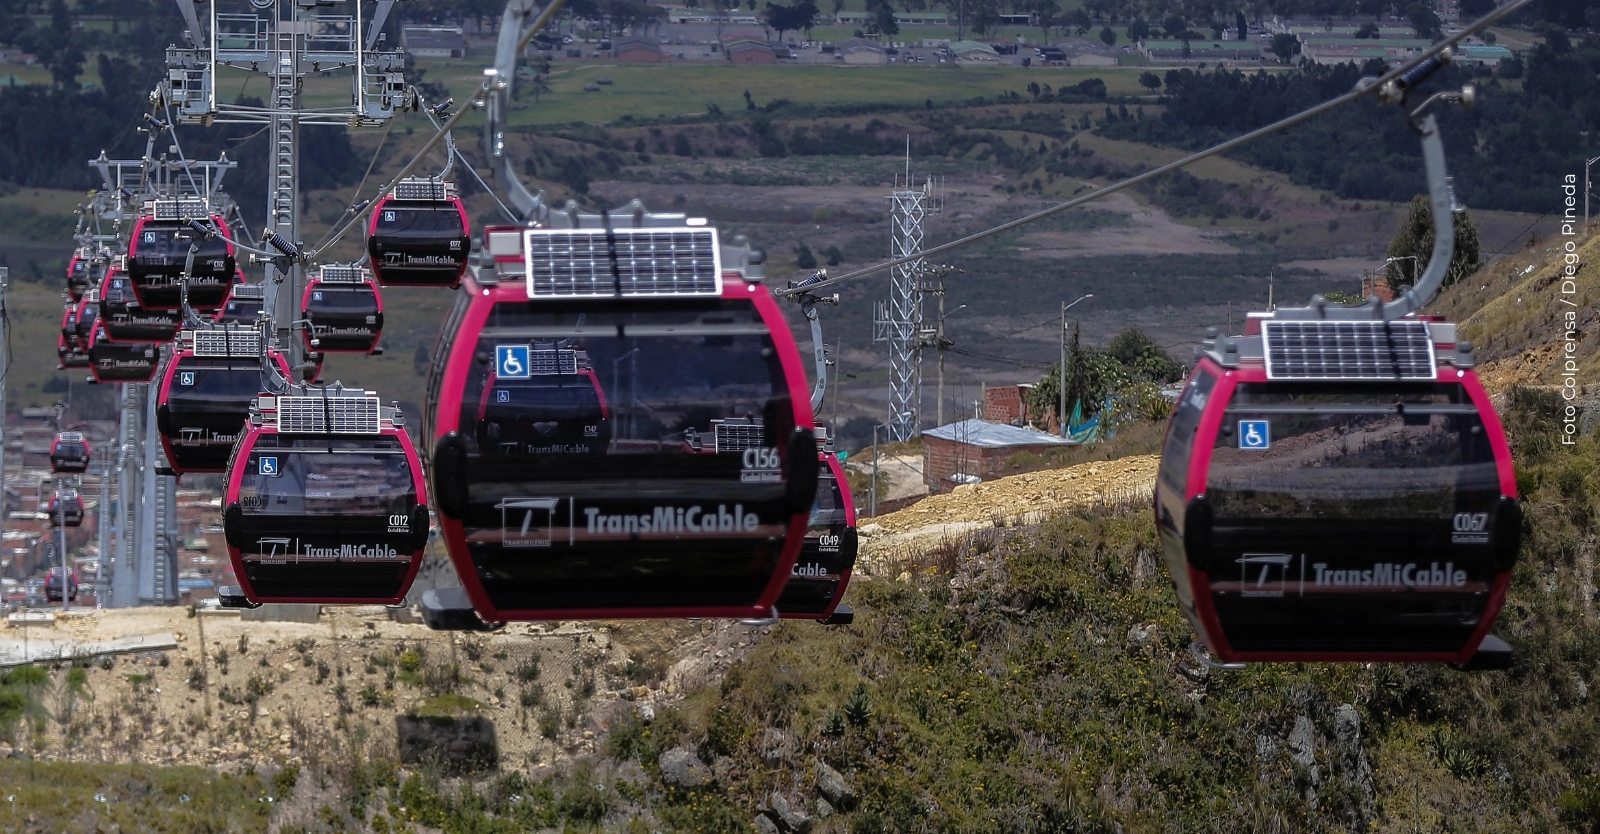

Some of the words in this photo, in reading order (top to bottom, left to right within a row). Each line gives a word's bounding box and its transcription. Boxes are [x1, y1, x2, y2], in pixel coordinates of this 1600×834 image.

[407, 255, 455, 264] TransMiCable
[331, 327, 372, 335] TransMiCable
[527, 444, 590, 454] TransMiCable
[742, 448, 779, 469] C156
[389, 514, 409, 526] C012
[584, 504, 759, 534] TransMiCable
[1453, 513, 1488, 531] C067
[819, 535, 839, 546] C049
[304, 544, 397, 559] TransMiCable
[1313, 562, 1467, 586] TransMiCable
